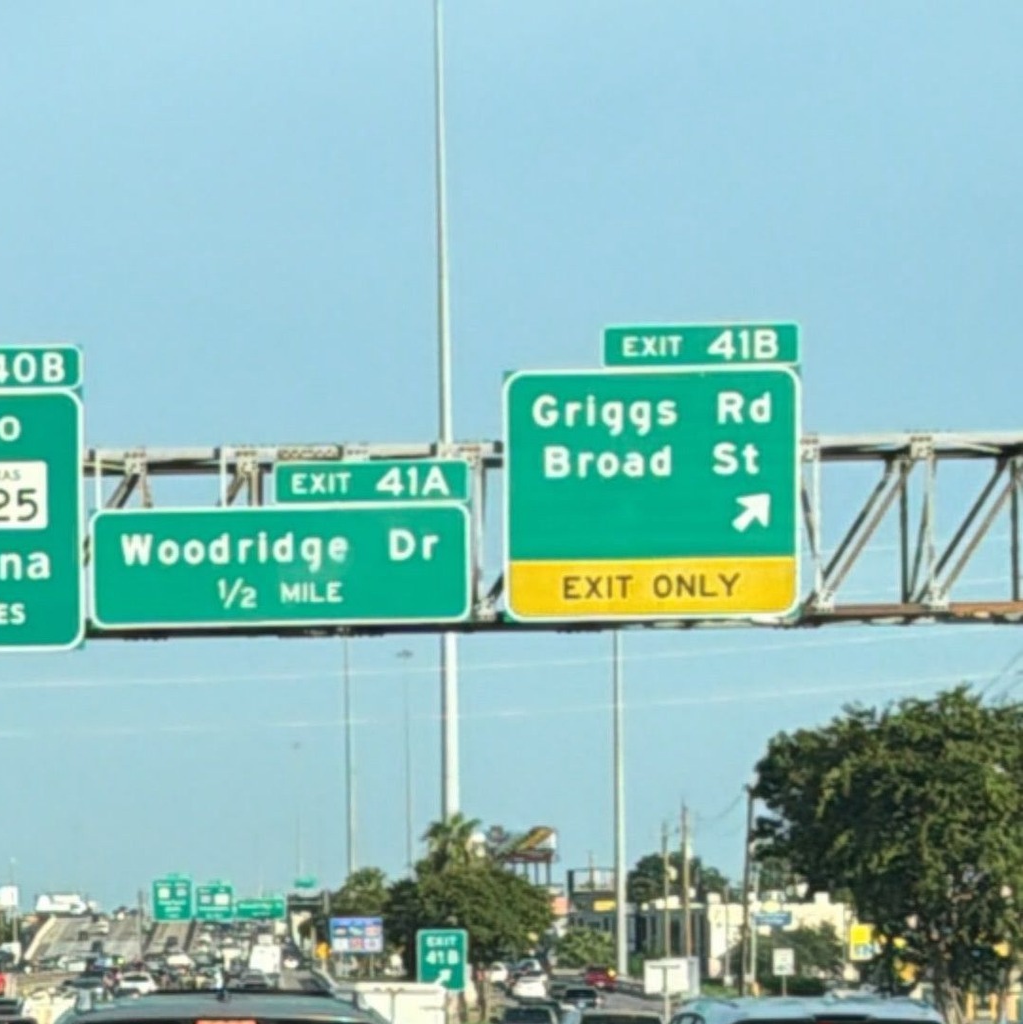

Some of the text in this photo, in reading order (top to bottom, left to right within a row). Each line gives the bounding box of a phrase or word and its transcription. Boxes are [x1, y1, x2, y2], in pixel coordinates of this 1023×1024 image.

[622, 329, 779, 359] EXIT 41B
[532, 391, 771, 436] Griggs Rd
[544, 442, 759, 478] Broad St
[291, 466, 450, 496] EXIT 41A
[121, 528, 439, 574] Woodridge Dr
[280, 580, 342, 602] MILE
[563, 573, 740, 600] EXIT ONLY
[426, 935, 457, 947] EXIT
